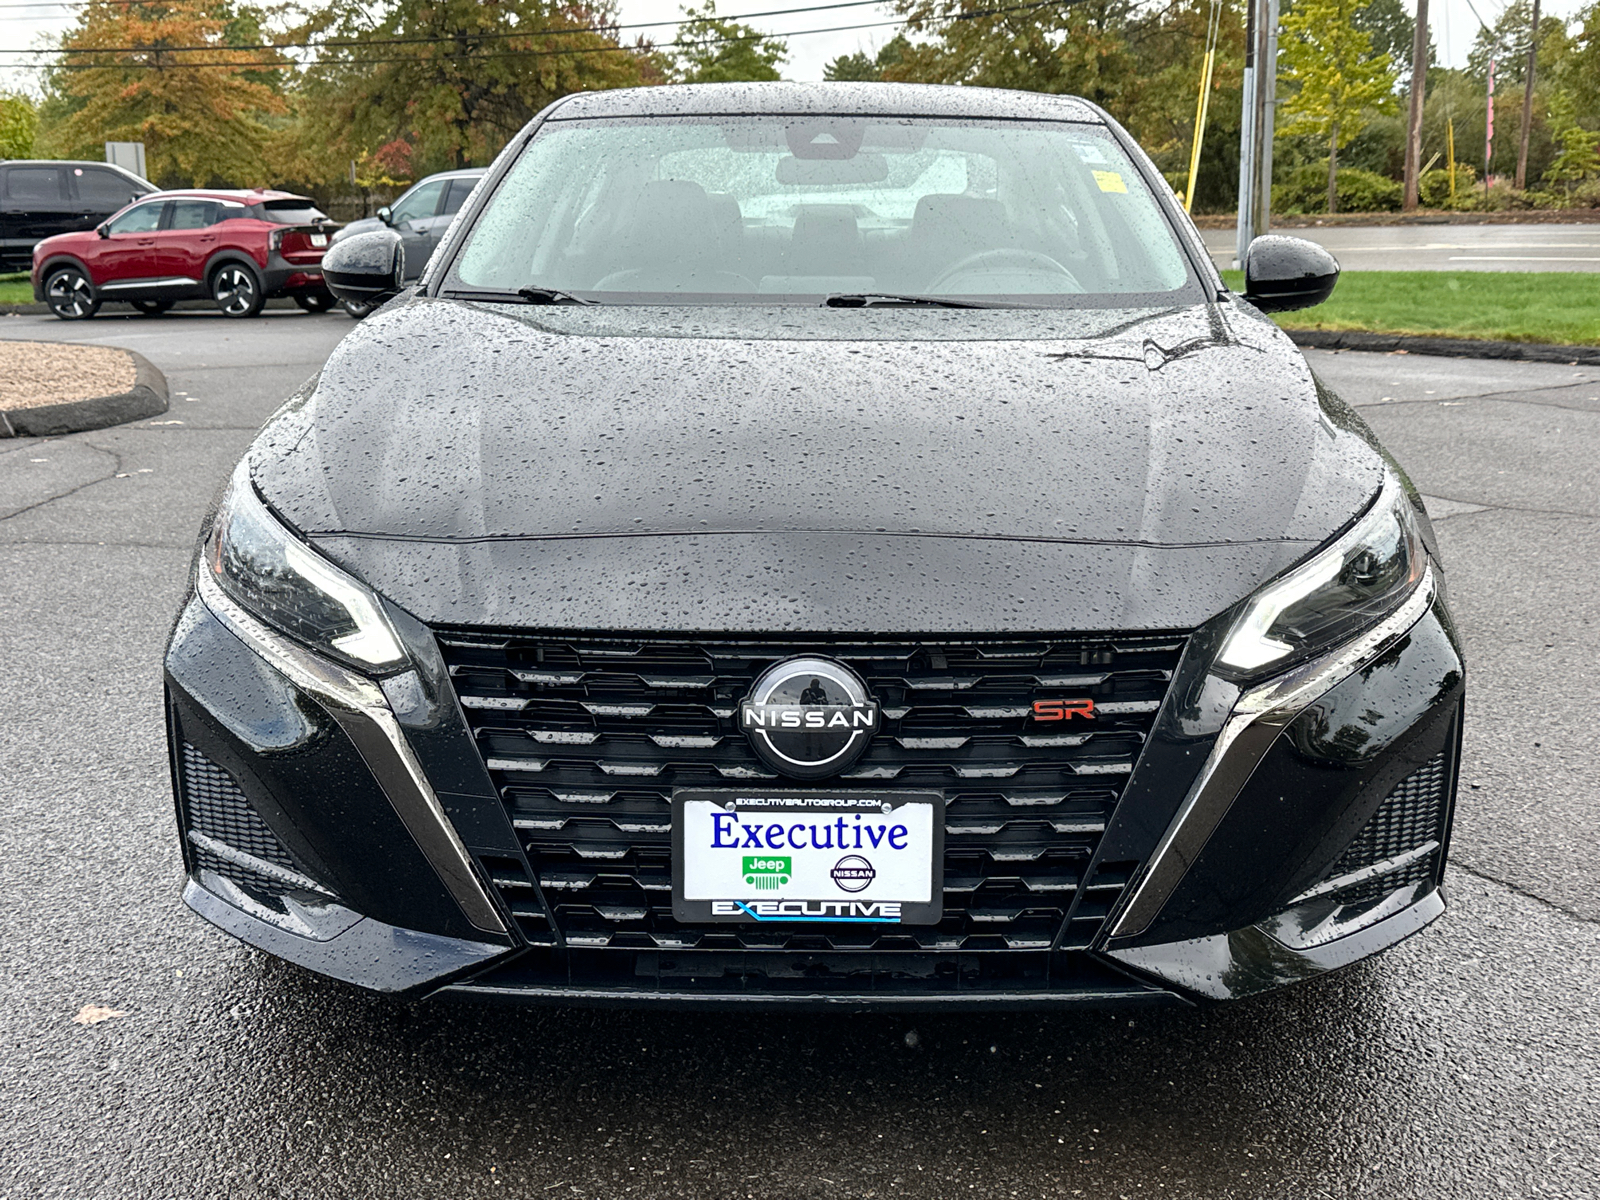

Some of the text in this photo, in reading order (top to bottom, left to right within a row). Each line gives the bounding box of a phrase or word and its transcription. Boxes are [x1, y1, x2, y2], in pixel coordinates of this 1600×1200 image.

[745, 708, 874, 728] NISSAN
[1033, 699, 1095, 721] SR
[735, 798, 882, 808] EXECUTIVEAUTOGROUP.COM
[710, 812, 908, 850] Executive
[749, 857, 786, 873] Jeep
[833, 869, 873, 878] NISSAN
[711, 900, 902, 917] EXECUTIVE
